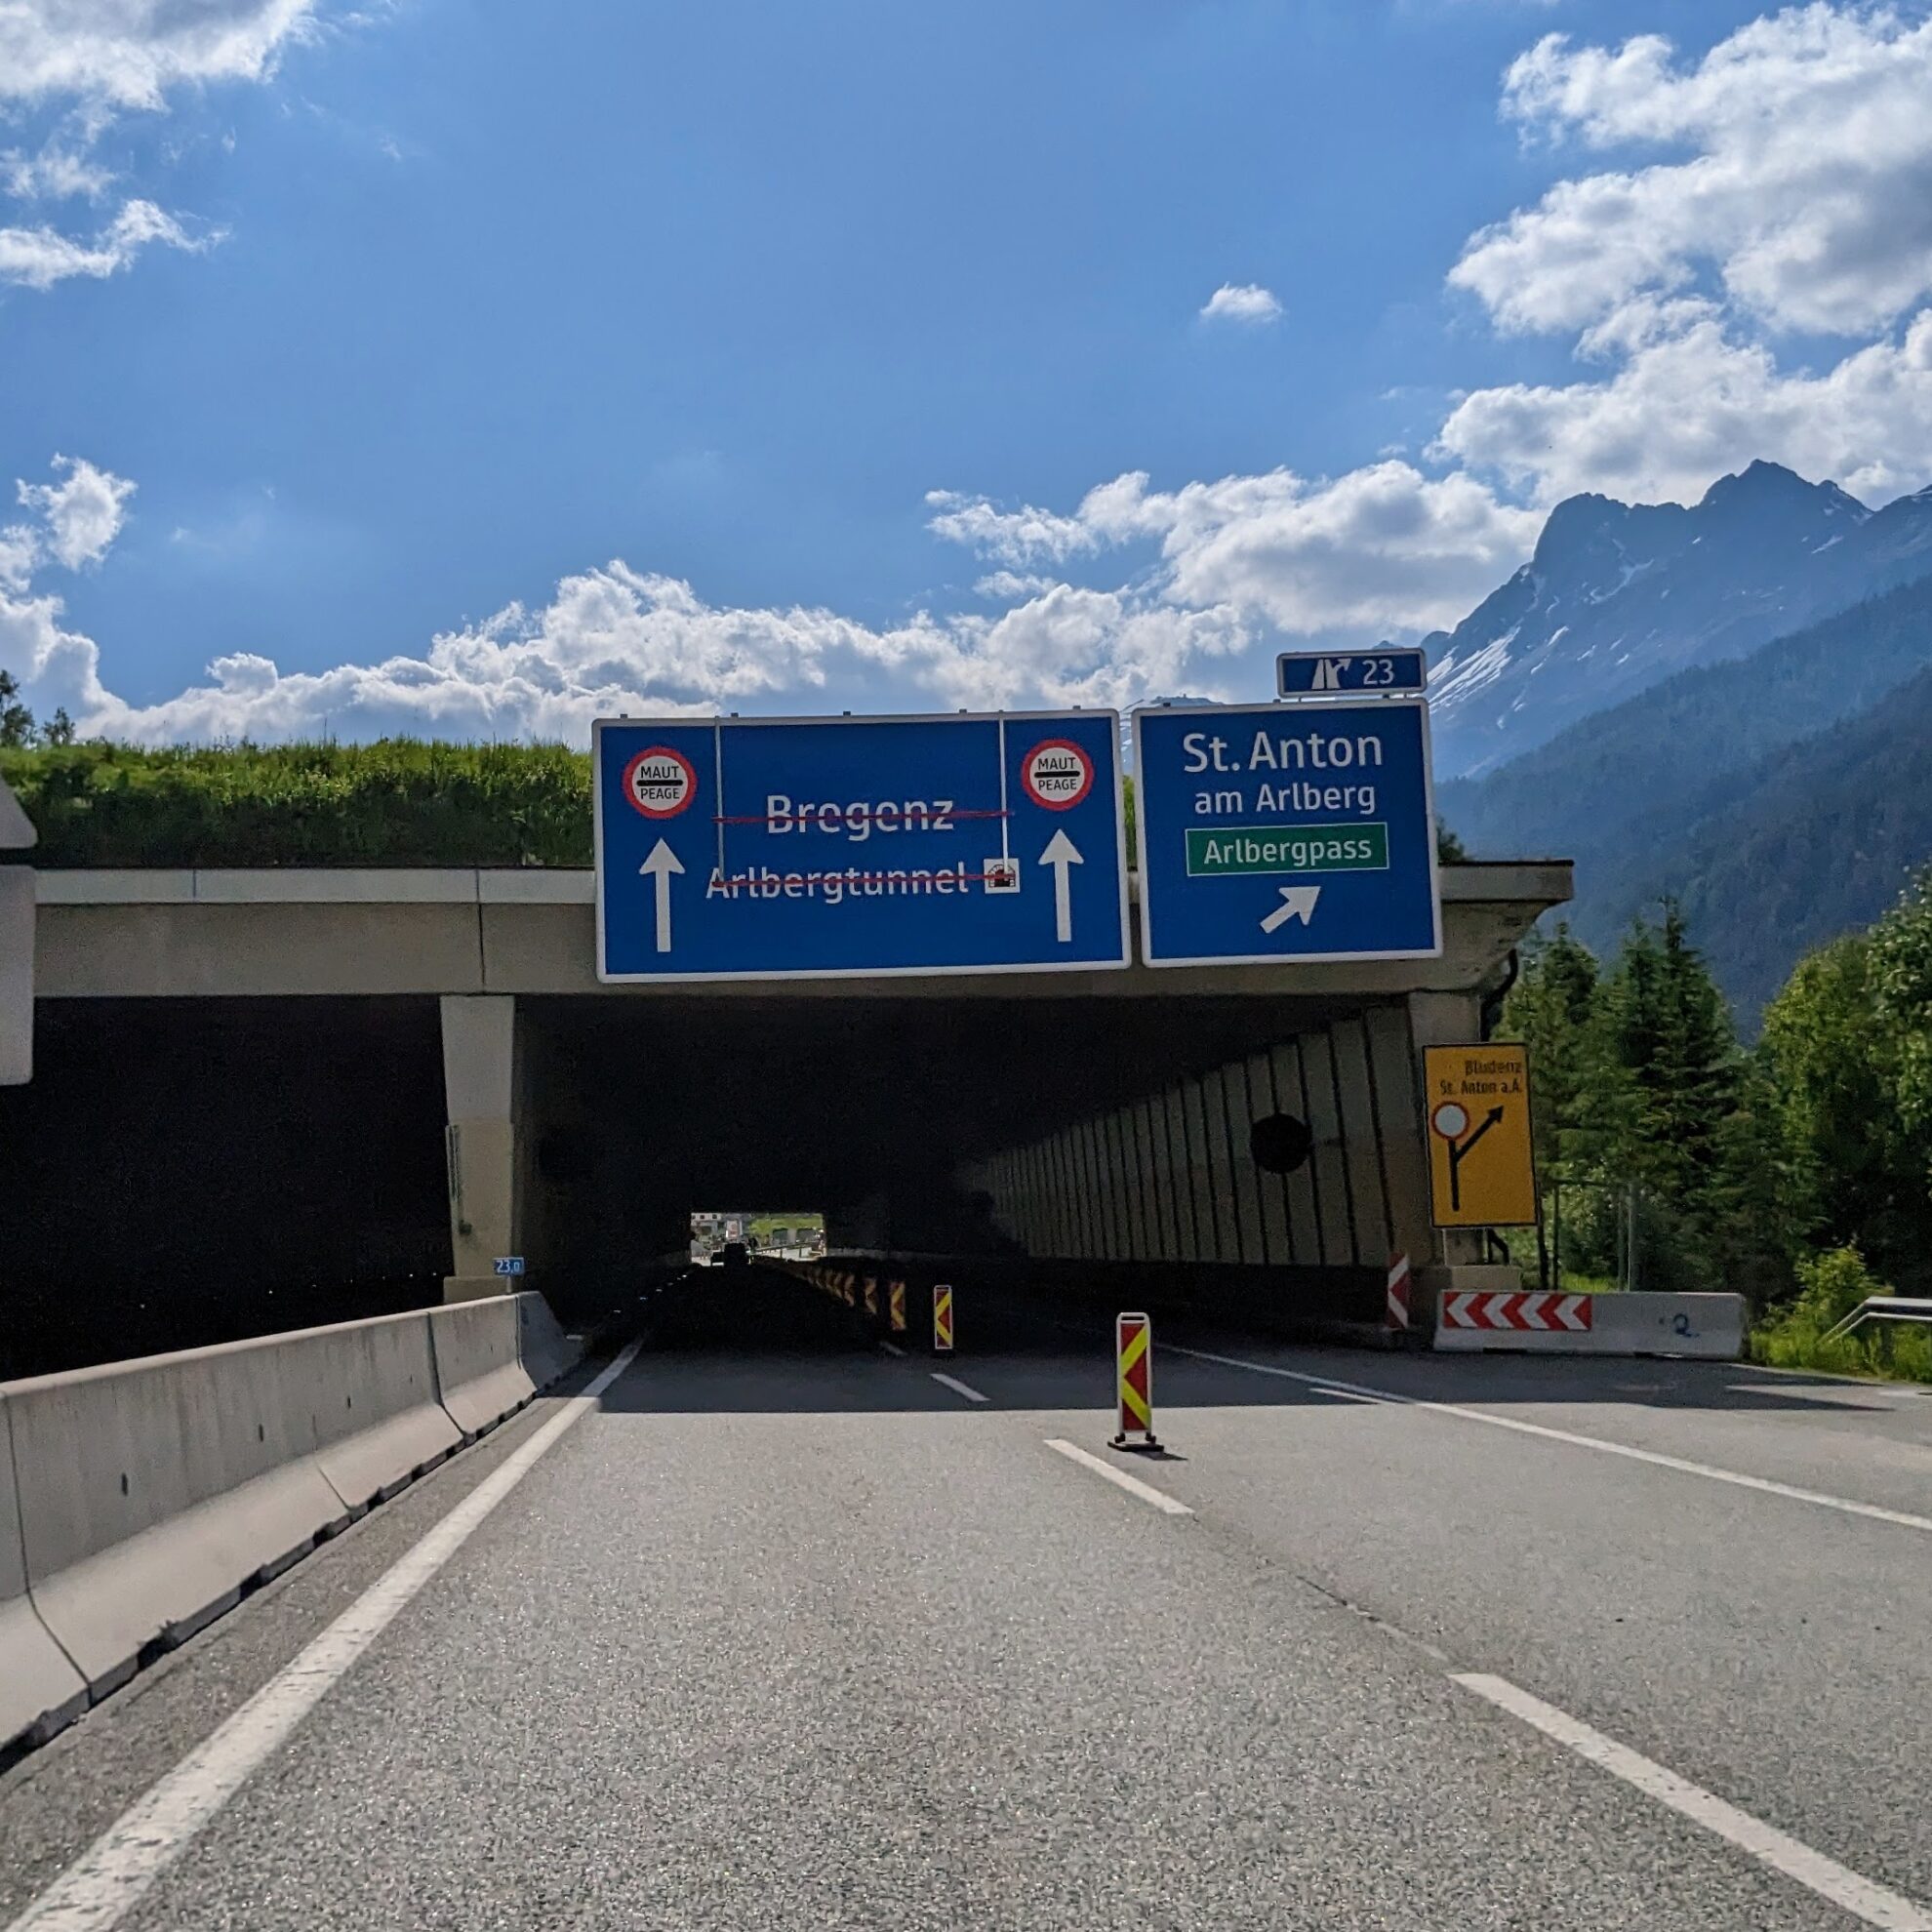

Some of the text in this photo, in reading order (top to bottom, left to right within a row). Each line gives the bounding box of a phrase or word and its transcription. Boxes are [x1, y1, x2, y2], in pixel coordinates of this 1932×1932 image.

[1362, 659, 1394, 685] 23
[1183, 731, 1383, 773] St. Anton
[640, 765, 679, 779] MAUT
[1037, 756, 1076, 771] MAUT
[640, 787, 680, 800] PEAGE
[1038, 779, 1077, 791] PEAGE
[1194, 782, 1376, 815] am Arlberg
[766, 794, 954, 841] Bregenz
[1203, 838, 1372, 866] Arlbergpass
[705, 861, 969, 904] Arlbergtunnel
[1465, 1060, 1522, 1075] Bludenz
[1461, 1078, 1497, 1095] Anton
